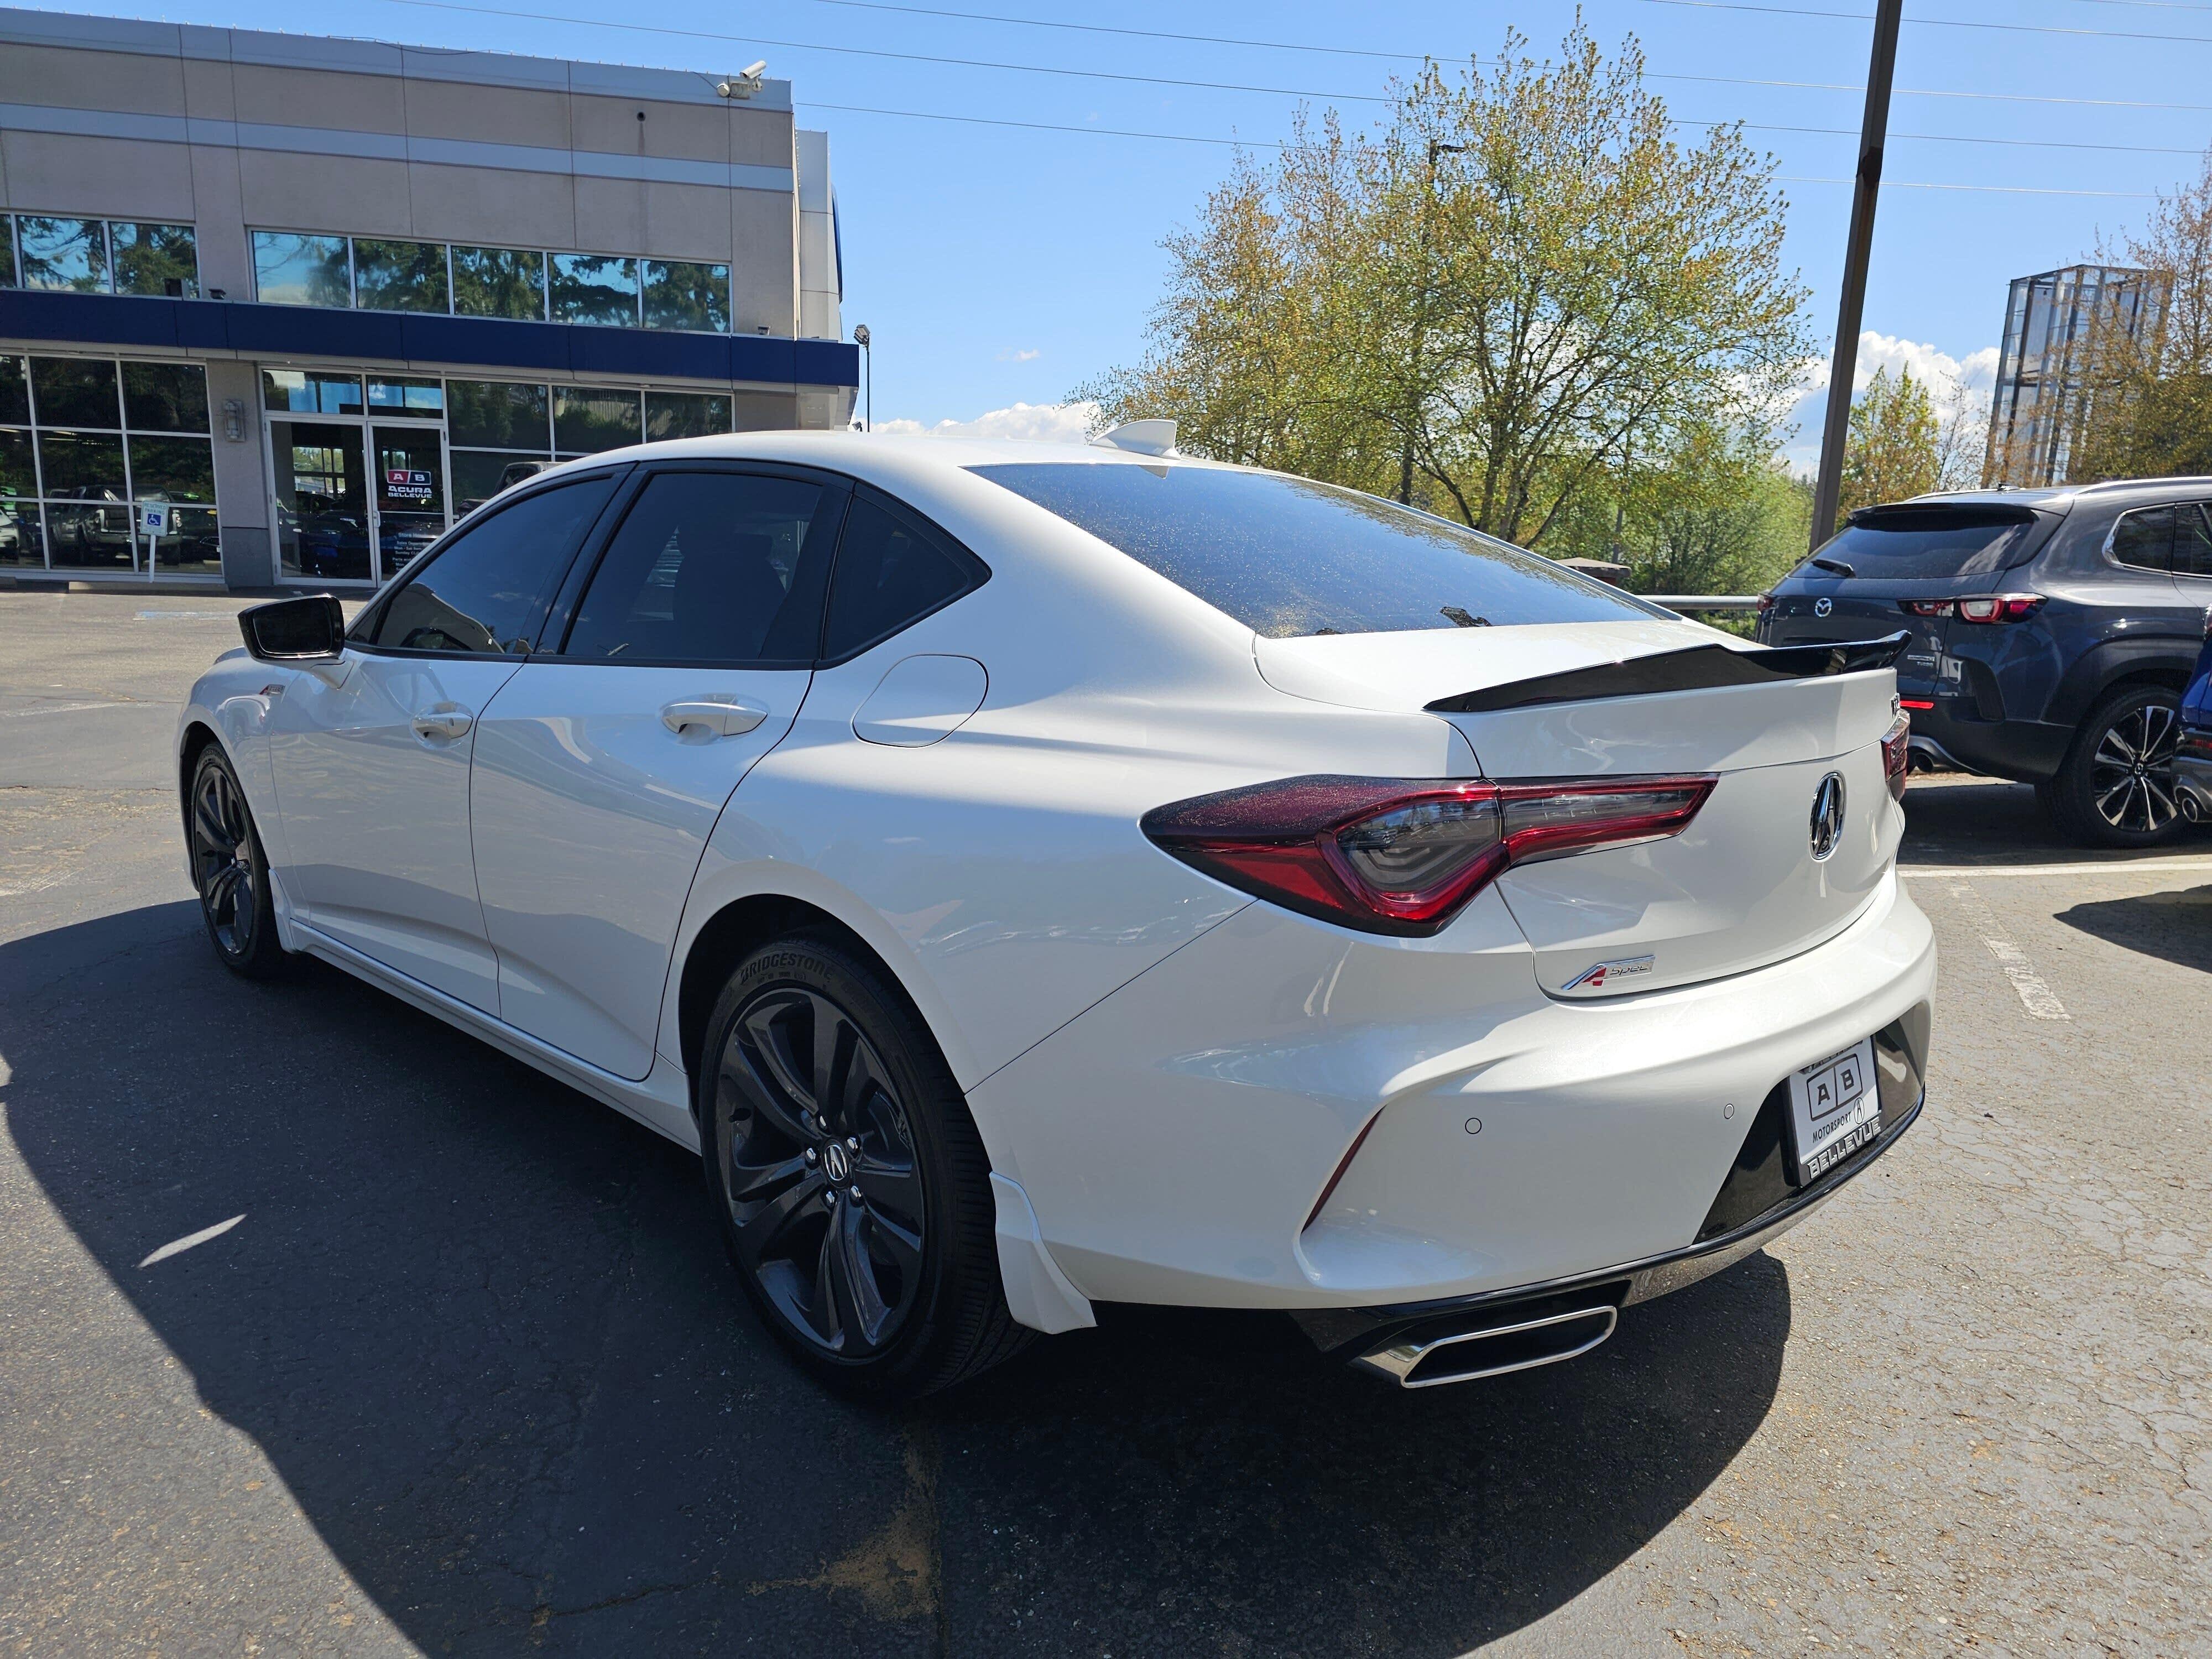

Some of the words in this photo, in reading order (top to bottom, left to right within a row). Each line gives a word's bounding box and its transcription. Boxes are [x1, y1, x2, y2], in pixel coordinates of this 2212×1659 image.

[388, 485, 432, 494] ACURA
[740, 952, 833, 985] BRIDGESTONE
[1818, 1083, 1830, 1105] A
[1840, 1069, 1854, 1091] B
[1812, 1112, 1851, 1144] MOTORSPORT
[1807, 1116, 1881, 1180] BELLEVUE
